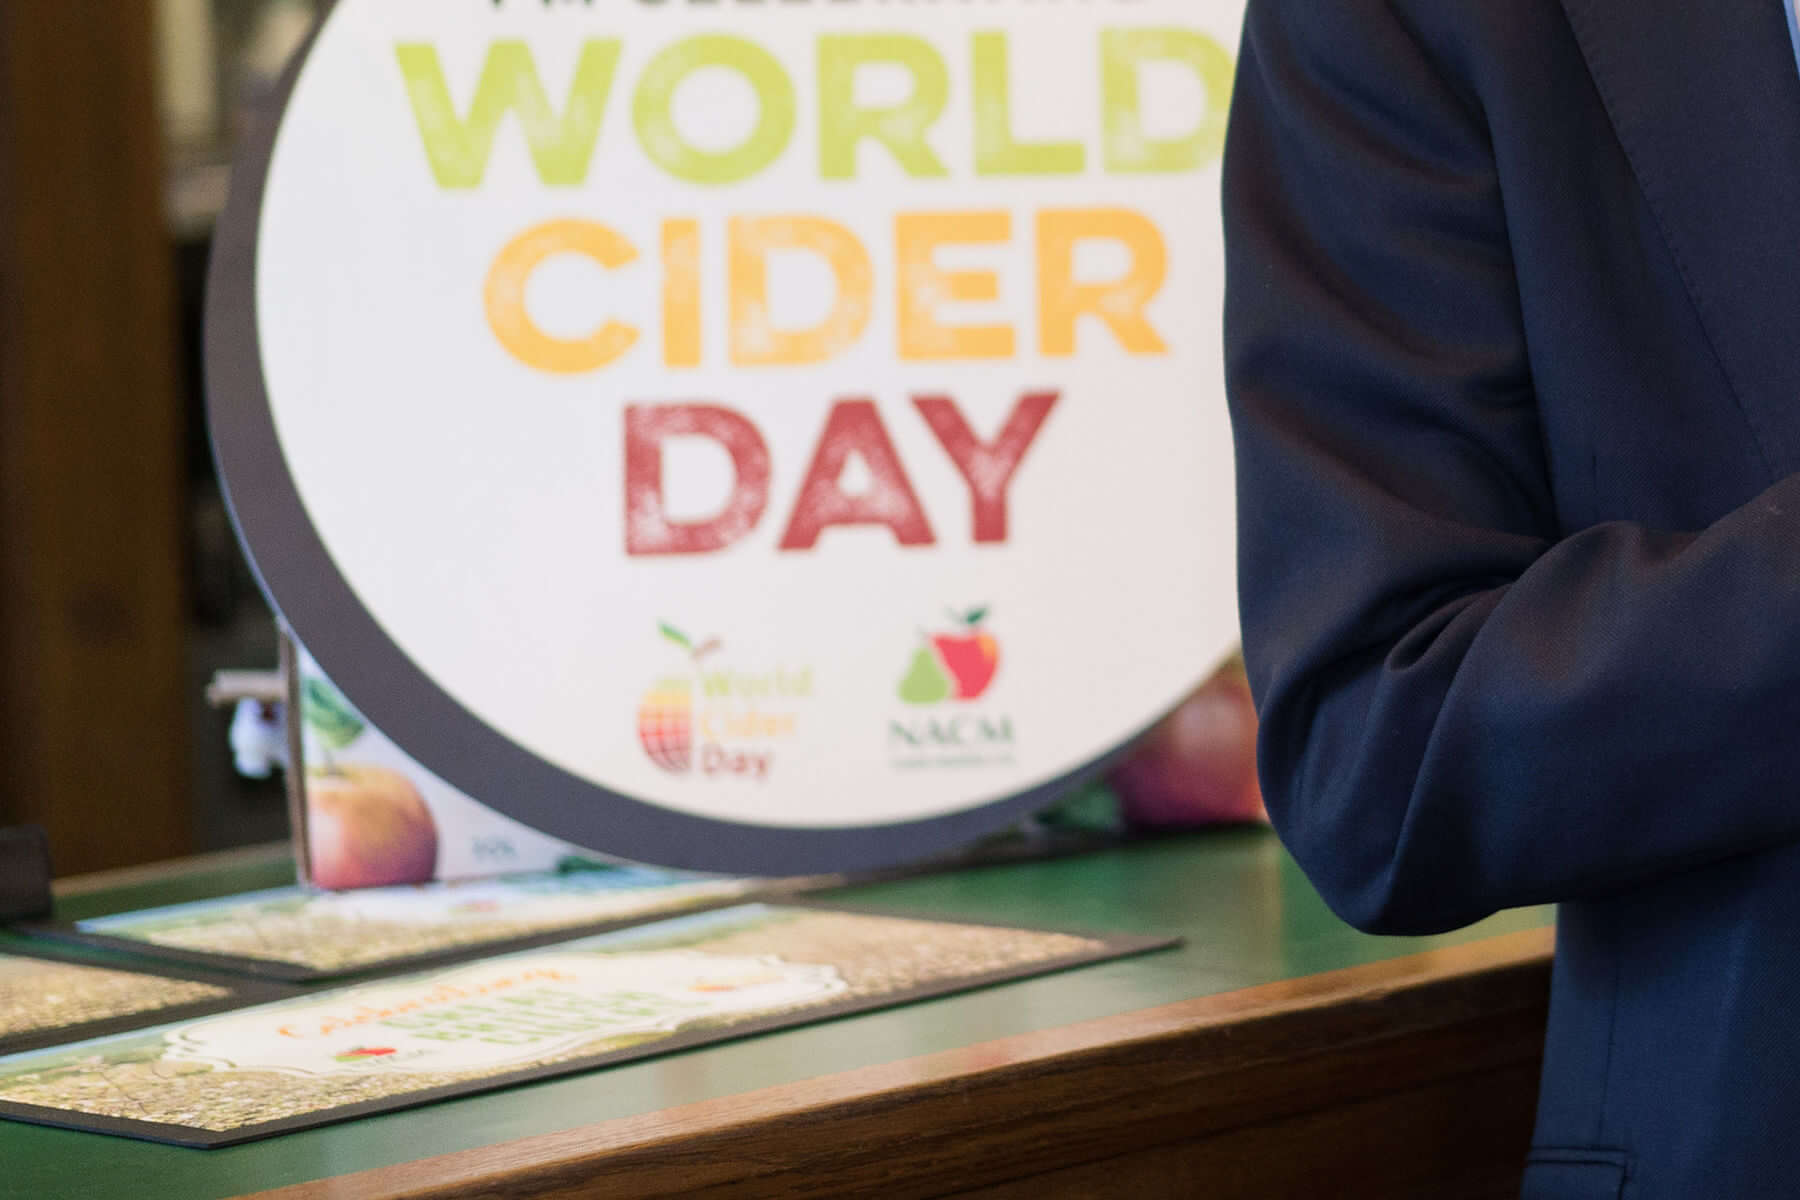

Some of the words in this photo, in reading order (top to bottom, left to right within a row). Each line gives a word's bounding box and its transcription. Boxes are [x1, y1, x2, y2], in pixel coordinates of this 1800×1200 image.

[395, 25, 1238, 190] WORLD
[483, 205, 1171, 375] CIDER
[622, 390, 1063, 557] DAY
[702, 745, 773, 779] Day
